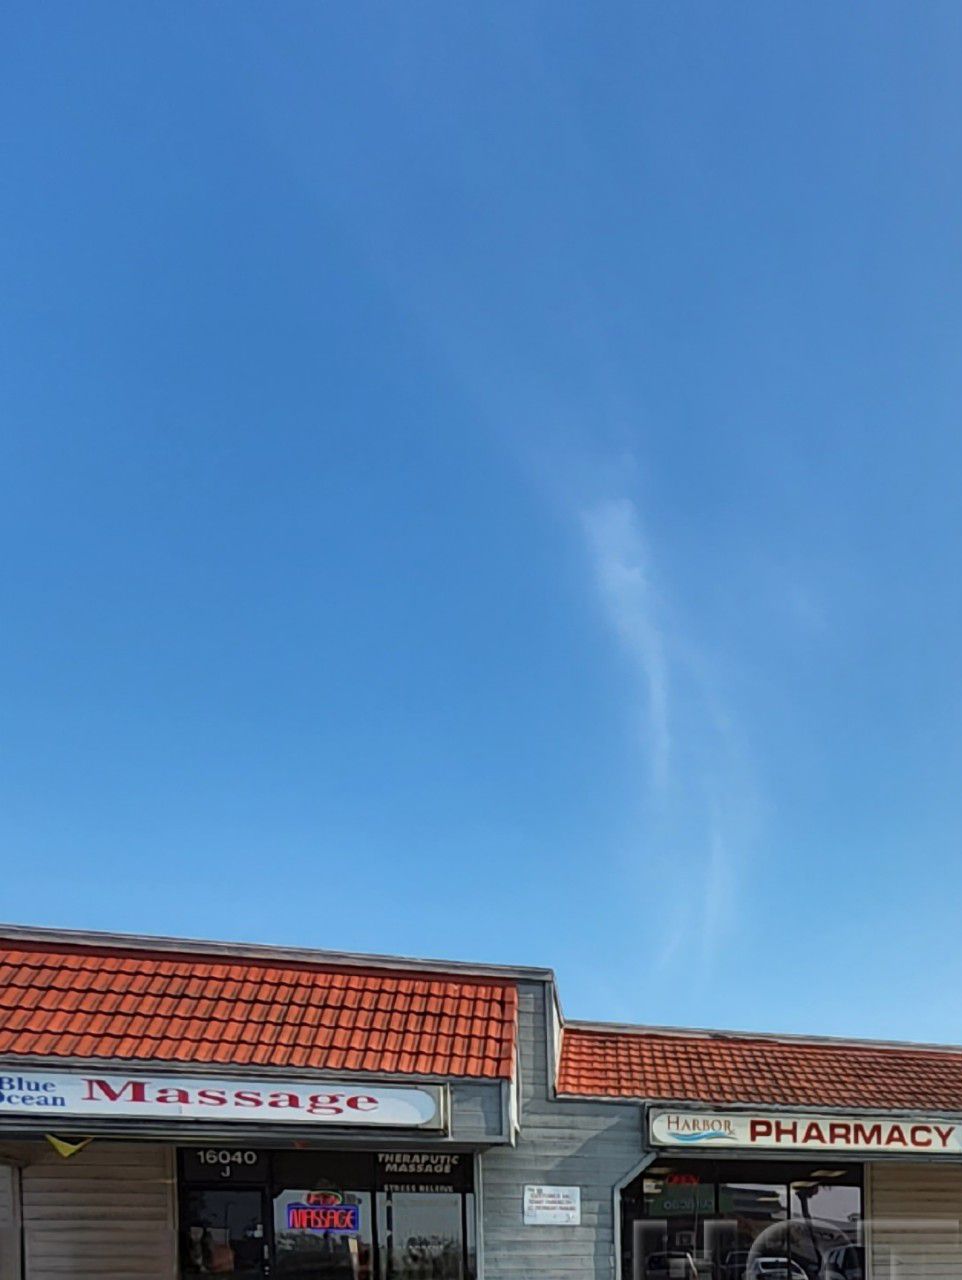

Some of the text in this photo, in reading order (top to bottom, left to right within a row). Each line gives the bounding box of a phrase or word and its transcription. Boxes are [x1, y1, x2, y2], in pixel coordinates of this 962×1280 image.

[0, 1076, 56, 1092] Blue
[81, 1078, 380, 1116] Massage
[750, 1119, 955, 1147] PHARMACY
[197, 1150, 257, 1165] 16040
[220, 1165, 231, 1178] J
[385, 1163, 451, 1174] MASSAGE
[289, 1208, 354, 1229] MASSAGE
